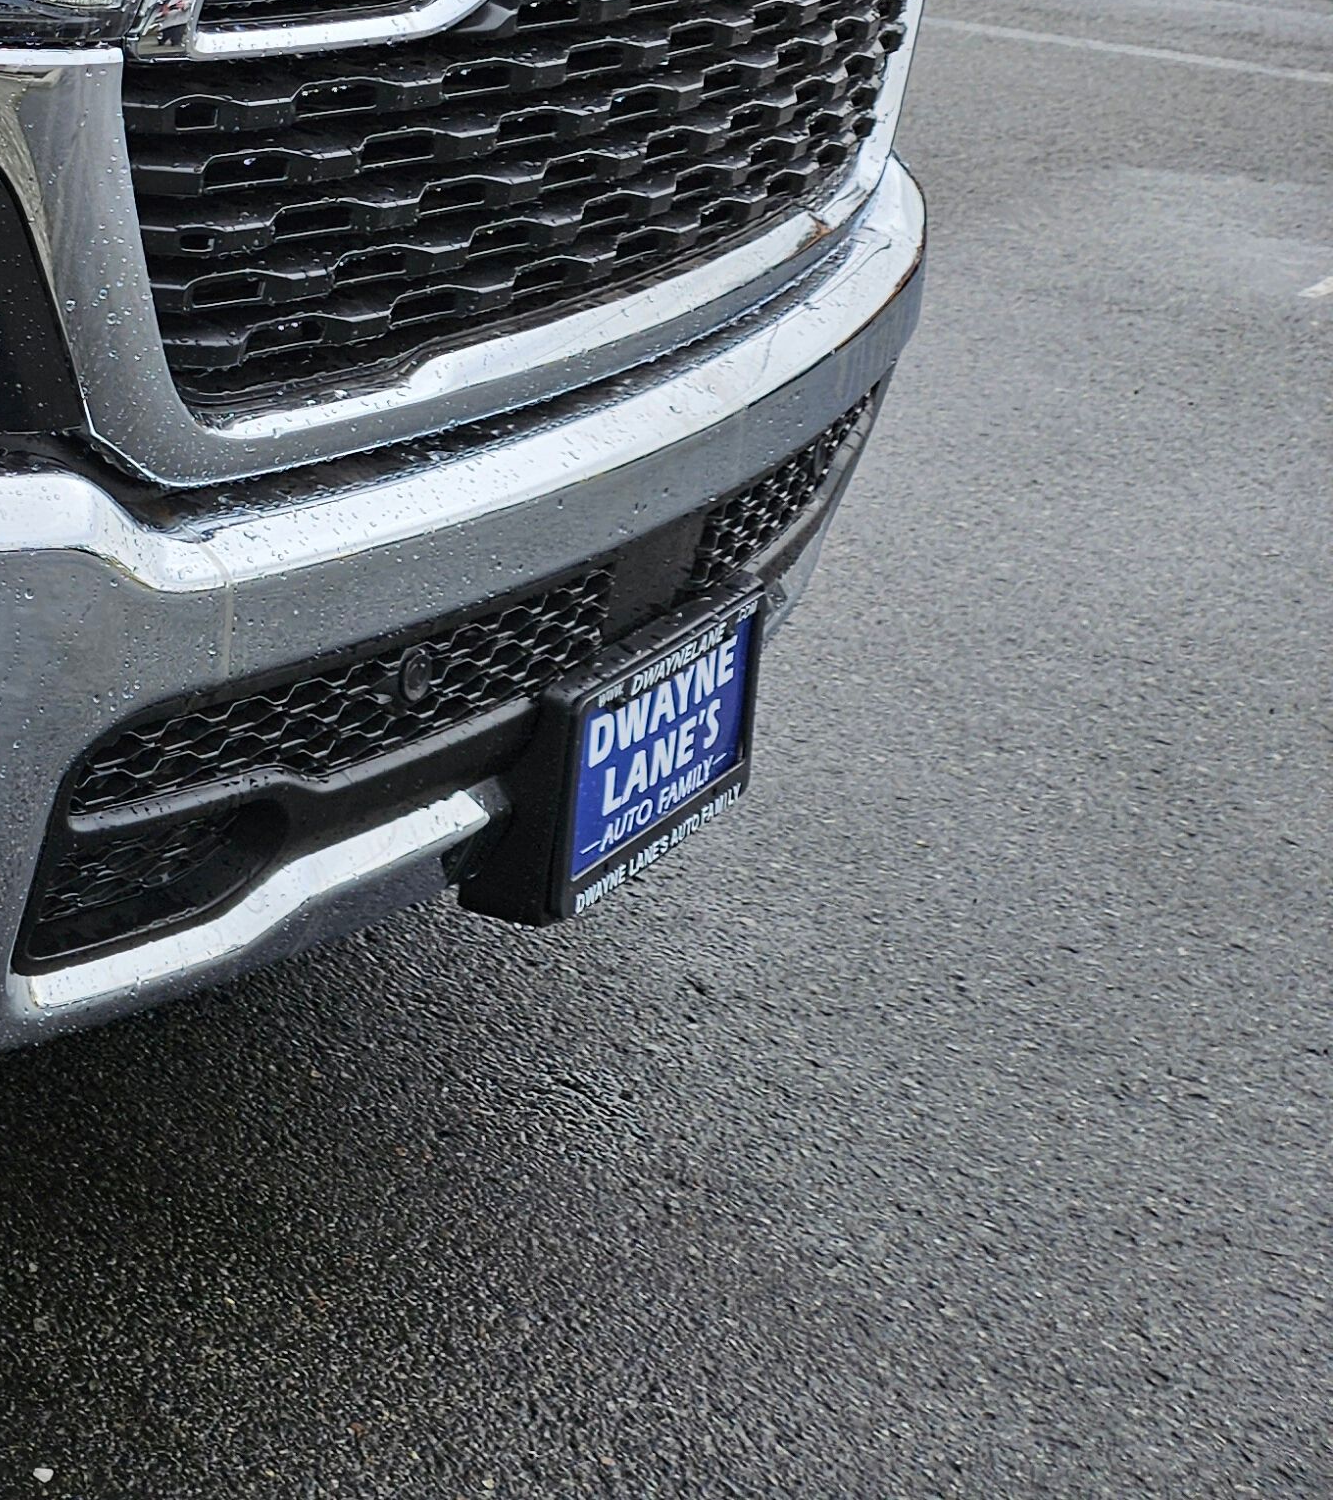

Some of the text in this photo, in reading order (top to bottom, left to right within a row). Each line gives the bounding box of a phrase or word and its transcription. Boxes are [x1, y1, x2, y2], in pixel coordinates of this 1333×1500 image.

[588, 635, 738, 768] DWAYNE
[631, 622, 727, 696] DWAYNELANE
[600, 755, 715, 852] AUTO FAMILY
[602, 699, 721, 816] LANE'S
[575, 863, 627, 915] DWAYNE
[670, 813, 700, 846] AUTO
[700, 782, 742, 826] FAMILY
